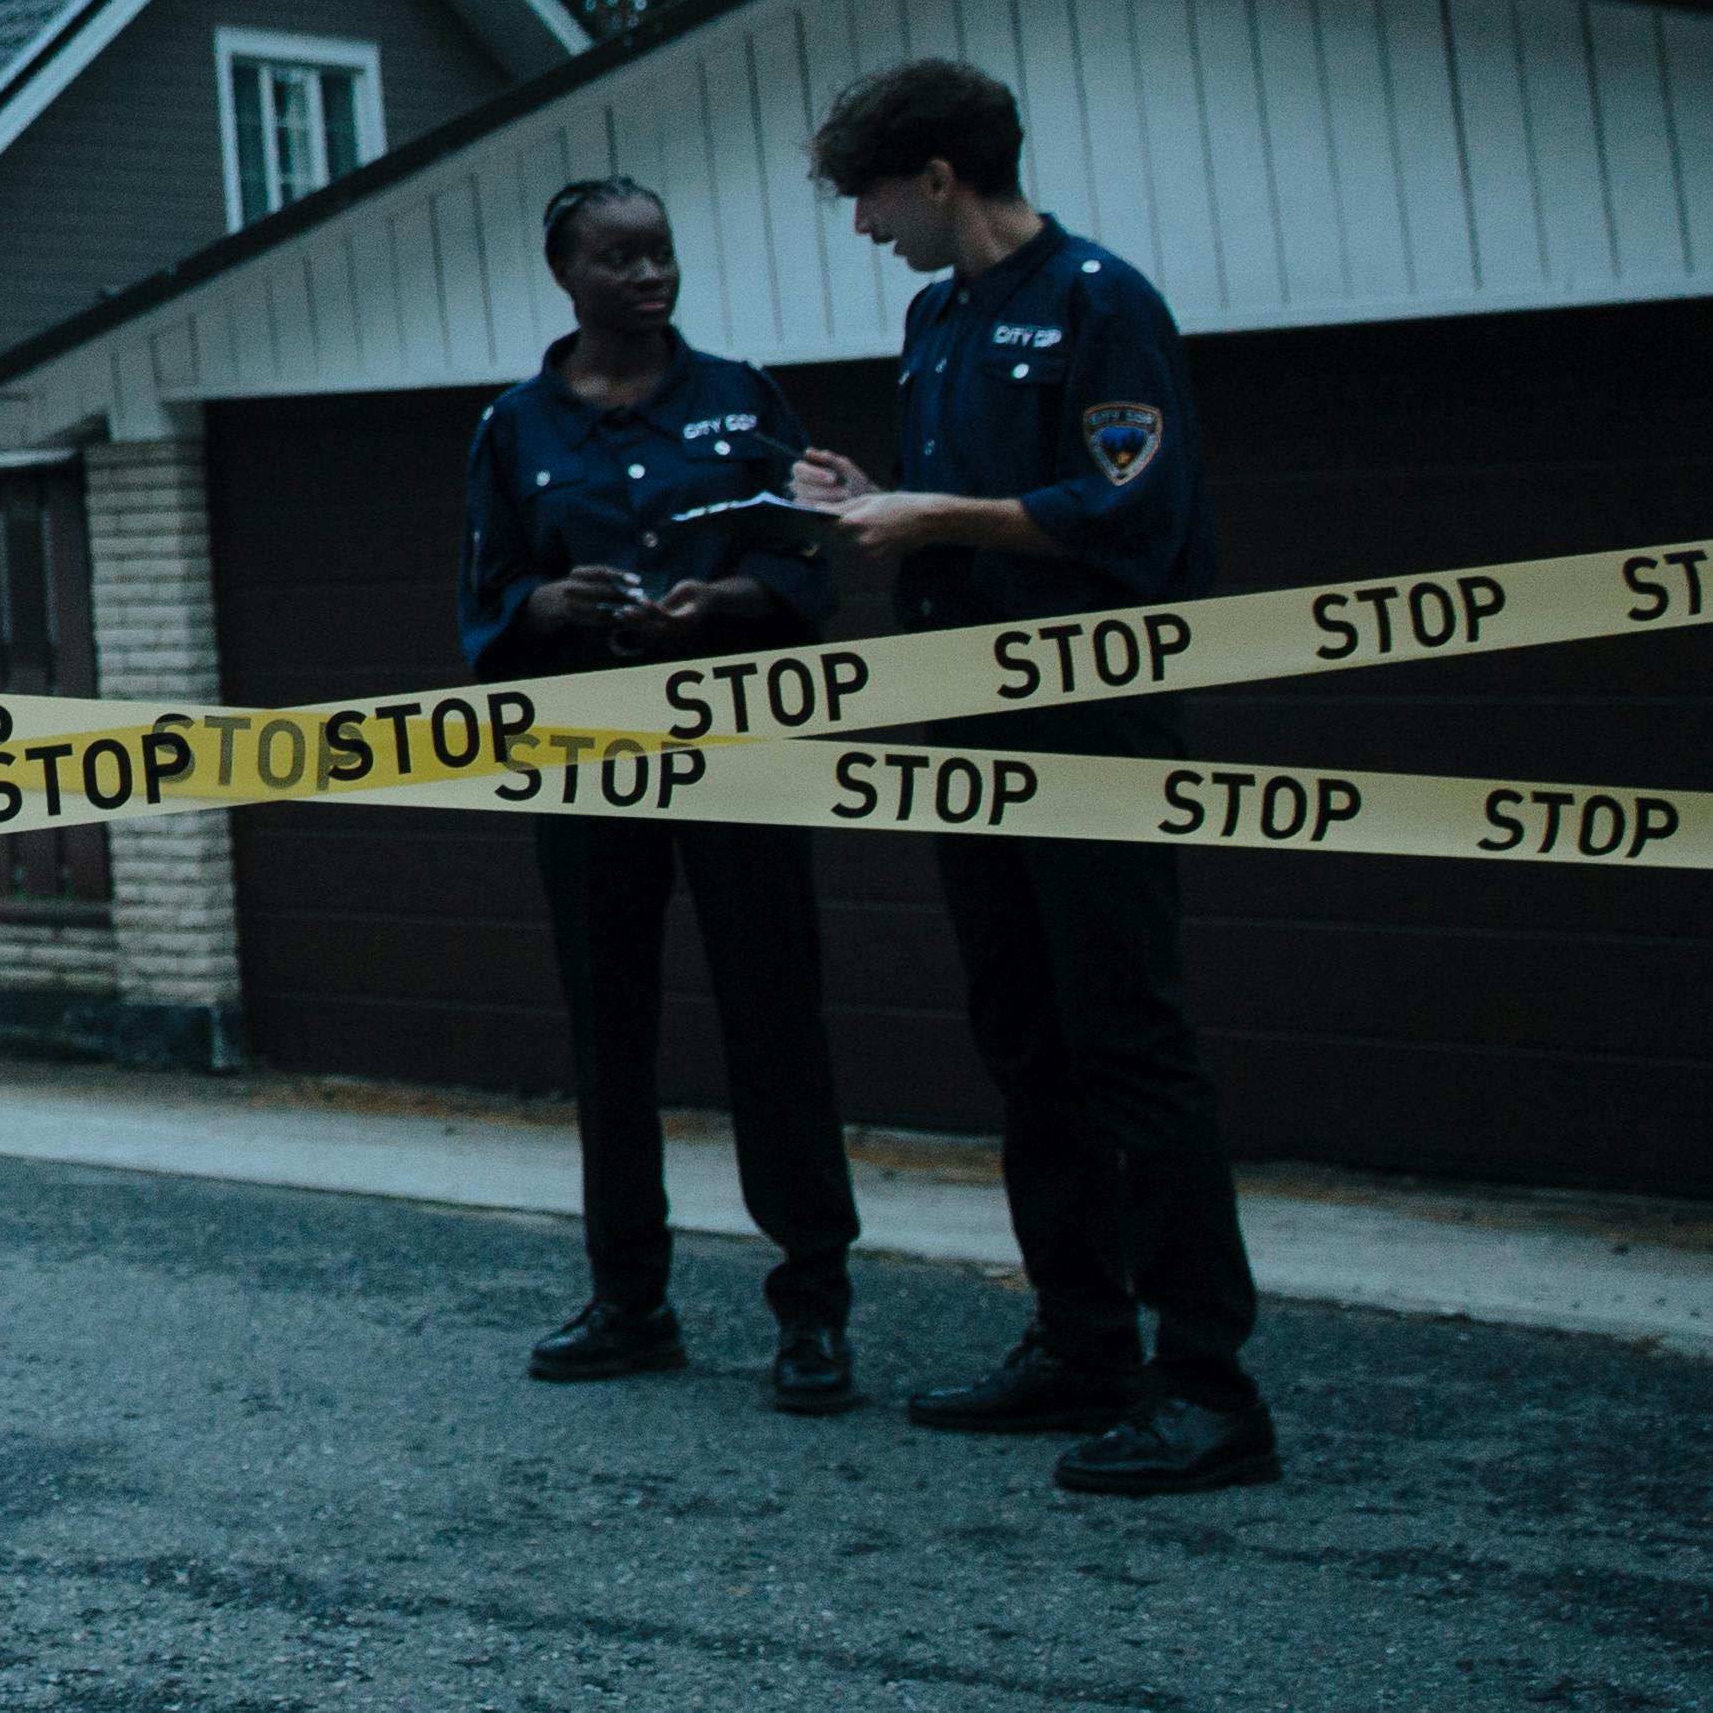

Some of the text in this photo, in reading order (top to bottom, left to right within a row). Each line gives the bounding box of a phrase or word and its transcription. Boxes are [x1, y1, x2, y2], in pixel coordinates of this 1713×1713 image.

[325, 691, 535, 781] STOP
[665, 652, 868, 739] STOP
[994, 613, 1191, 699] STOP
[1313, 576, 1505, 660] STOP
[149, 713, 365, 791] STOP
[494, 734, 706, 809] STOP
[831, 751, 1037, 825] STOP
[1158, 770, 1361, 841] STOP
[1477, 789, 1679, 858] STOP
